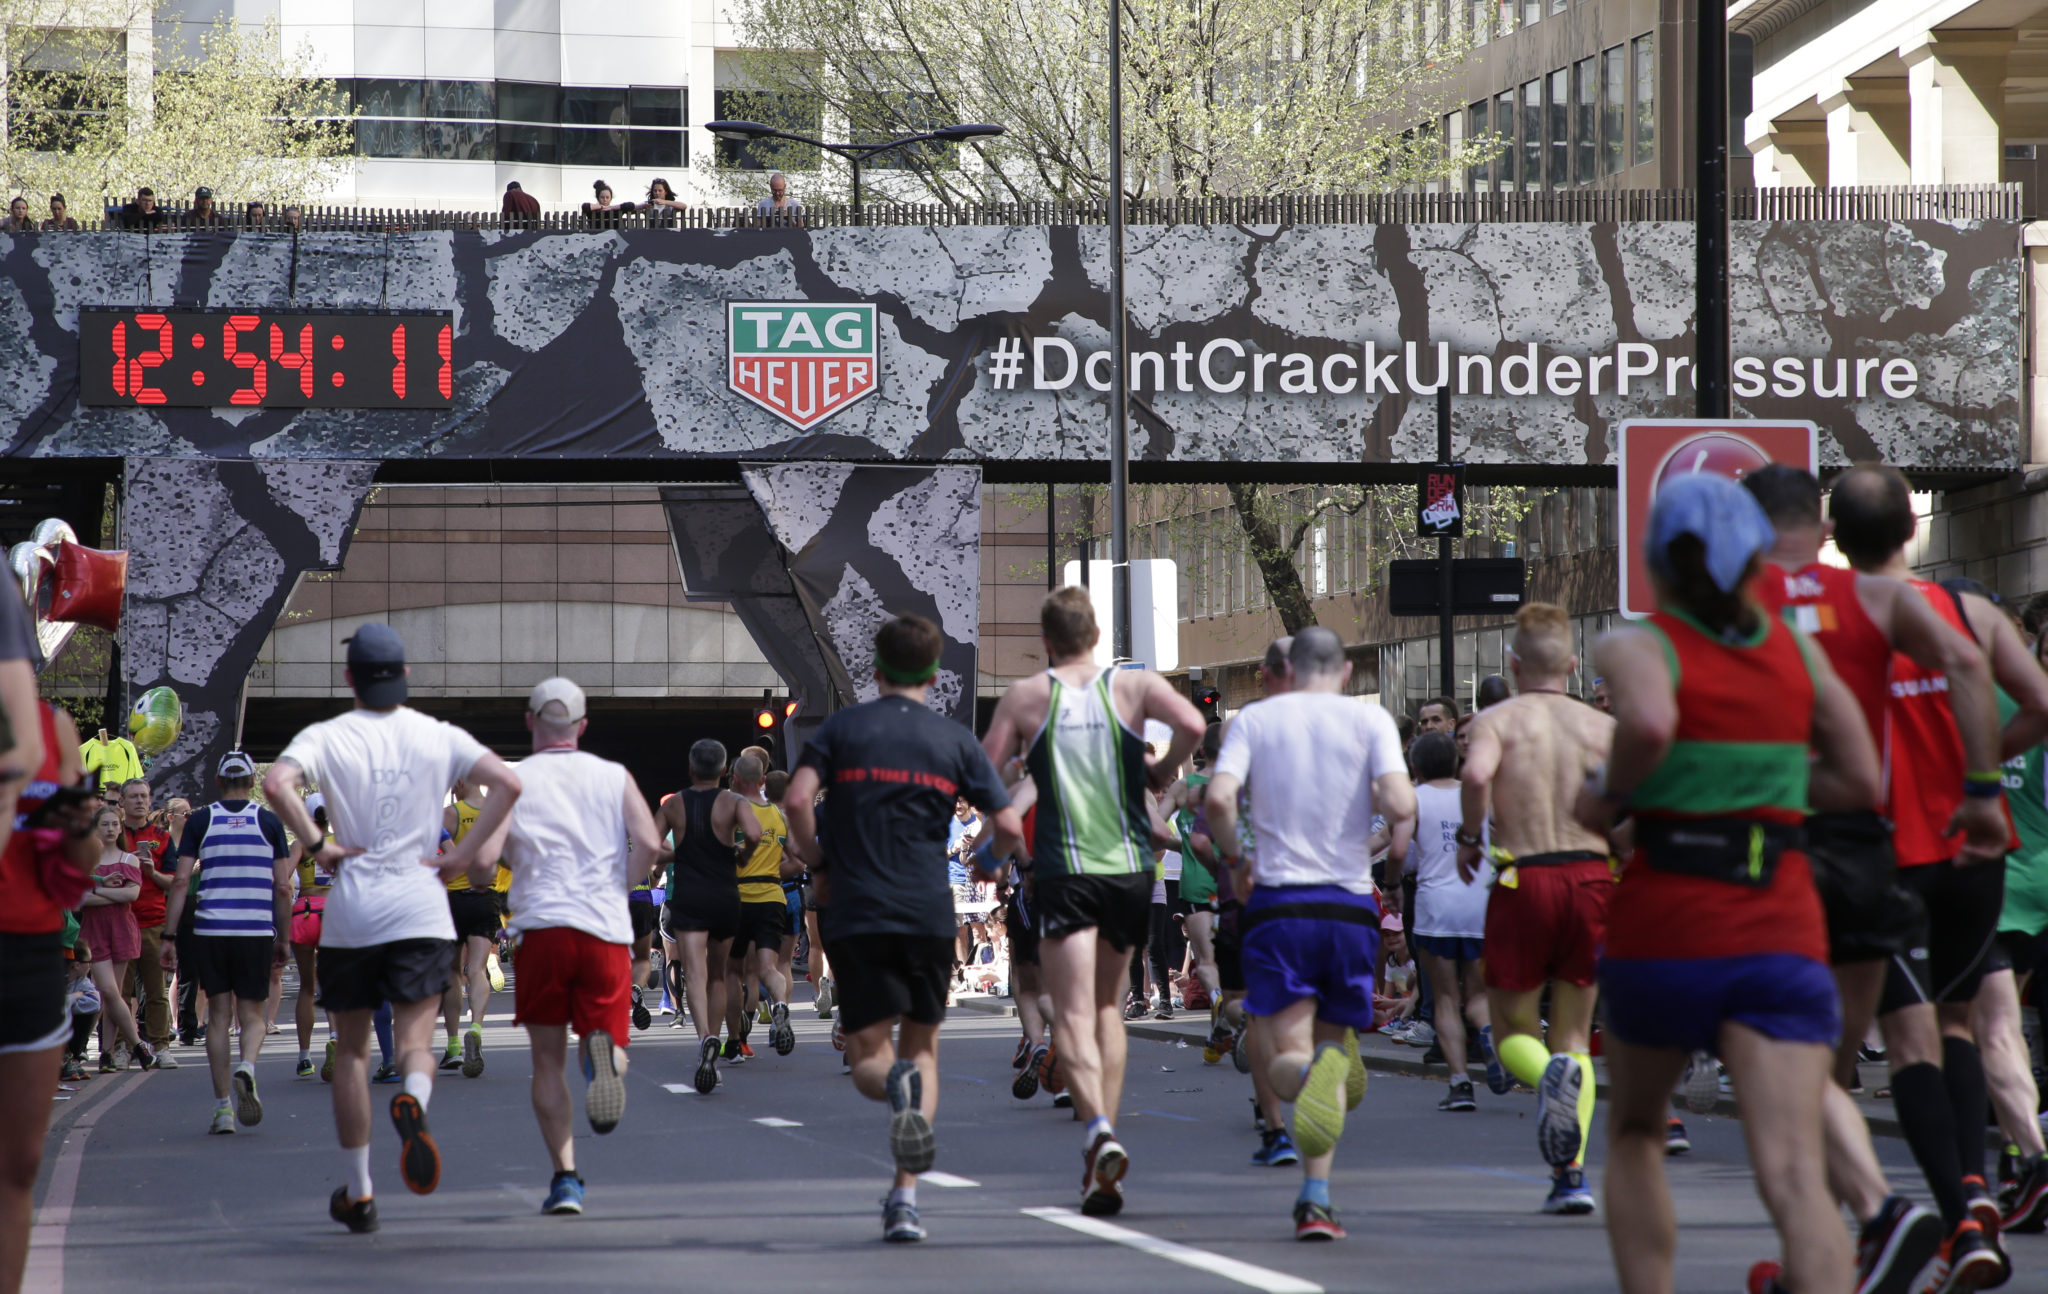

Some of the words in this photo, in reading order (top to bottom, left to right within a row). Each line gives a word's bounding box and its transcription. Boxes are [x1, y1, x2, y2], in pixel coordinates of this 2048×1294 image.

[741, 311, 863, 349] TAG
[738, 360, 869, 420] HEUER
[988, 336, 1919, 399] #DontCrackUnderPrssure
[1427, 473, 1456, 488] RUN
